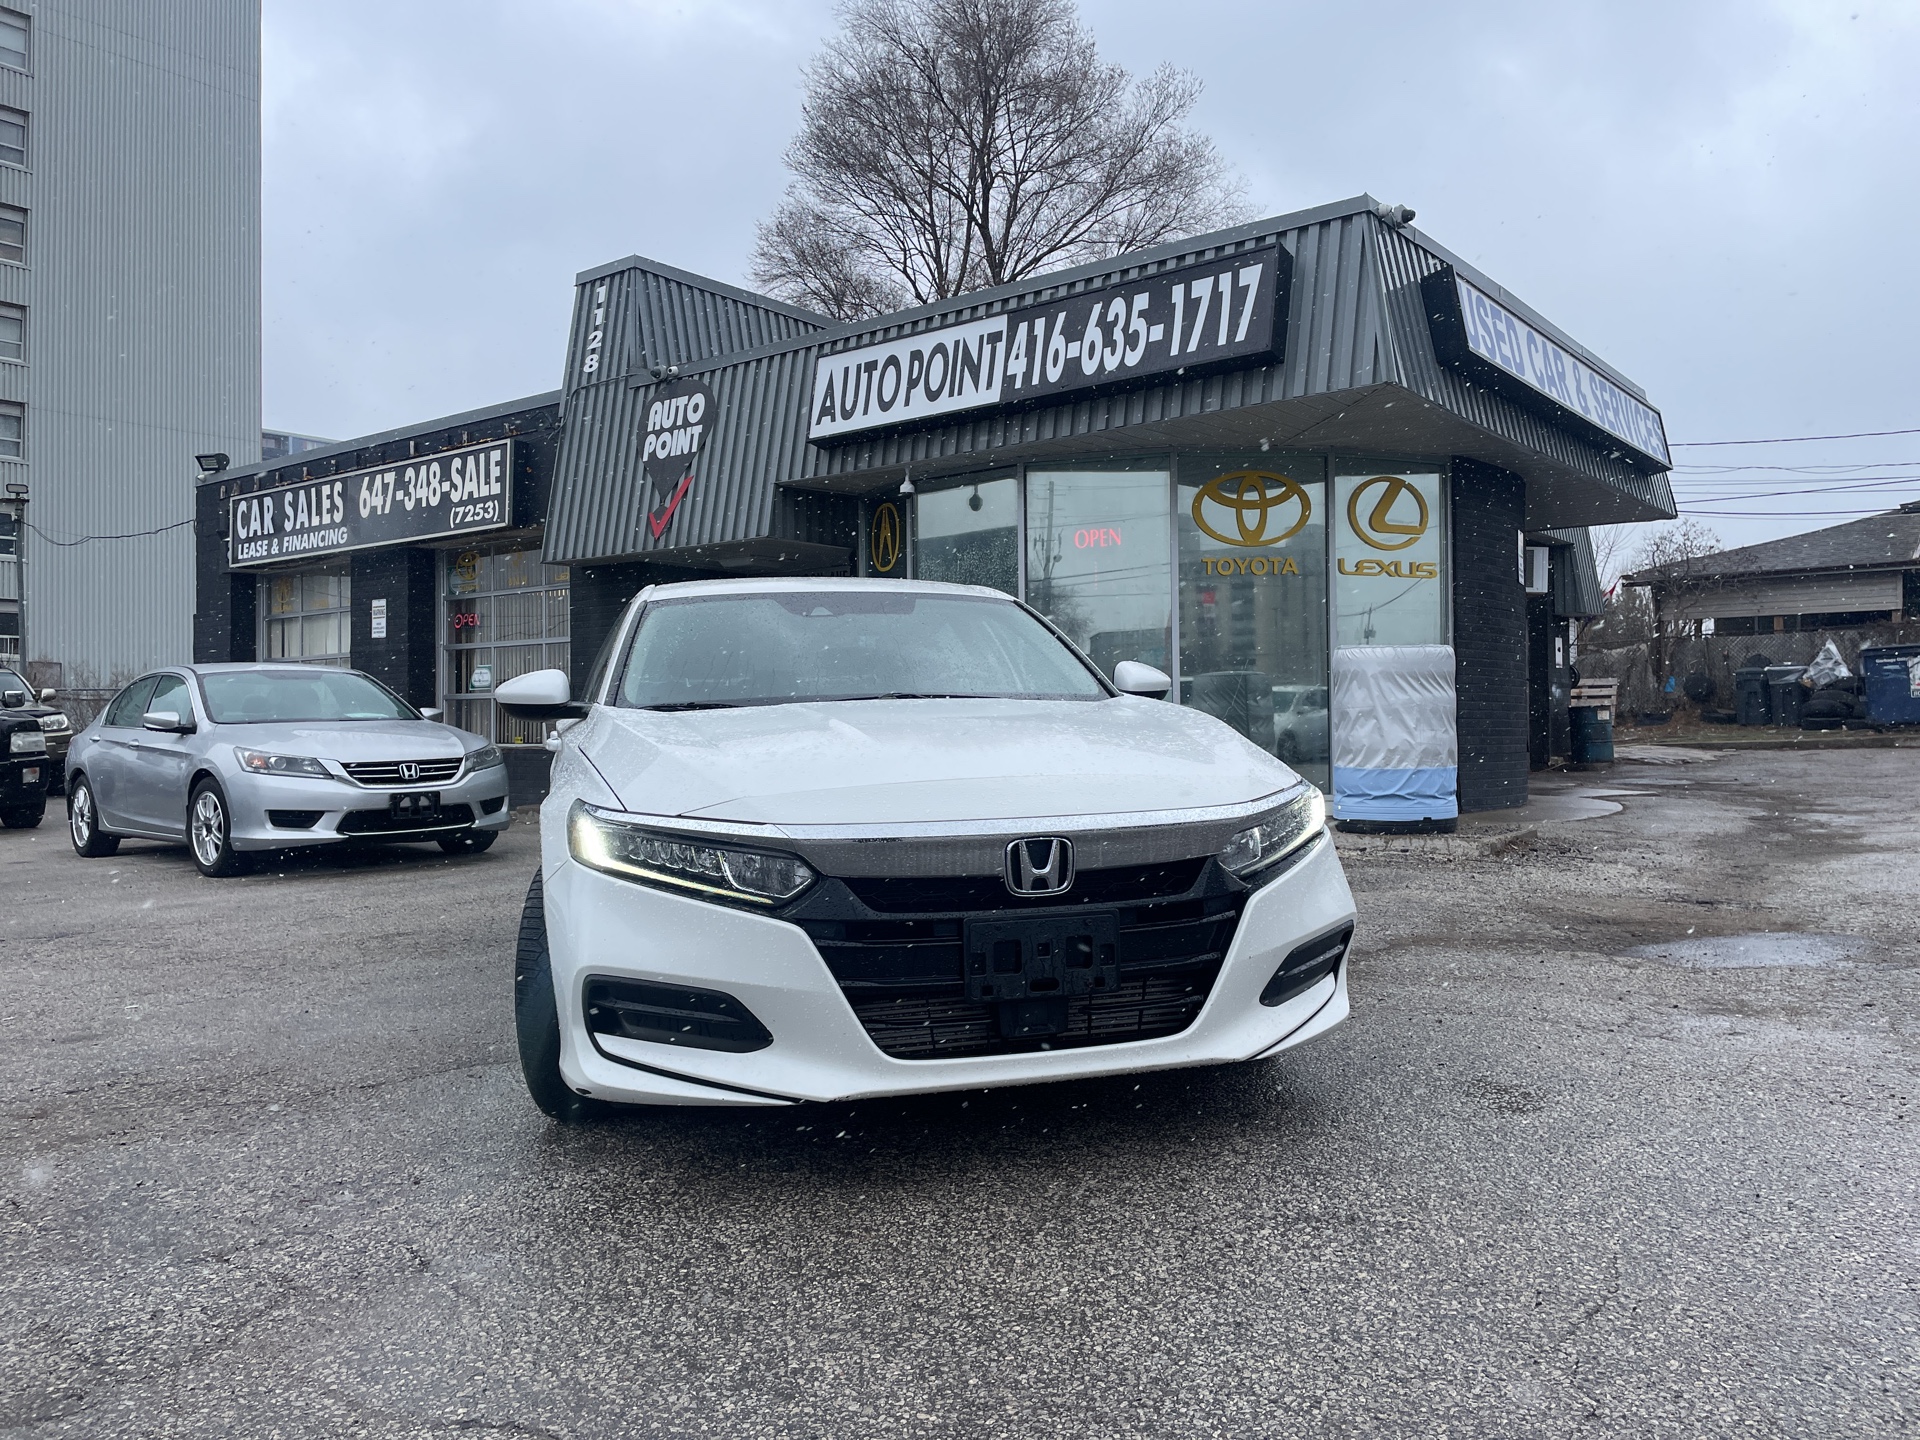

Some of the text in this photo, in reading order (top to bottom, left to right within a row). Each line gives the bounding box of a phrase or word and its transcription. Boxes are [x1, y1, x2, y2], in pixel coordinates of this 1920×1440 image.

[583, 285, 607, 373] 1128
[1007, 263, 1263, 389] 416-635-1717
[815, 329, 1003, 425] AUTO POINT
[1457, 281, 1667, 461] USED CAR & SERVICES
[647, 393, 705, 432] AUTO
[643, 425, 702, 462] POINT
[236, 449, 501, 540] CAR SALES 647-348-SALE
[450, 500, 499, 528] (7253)
[238, 527, 348, 560] LEASE & FINANCING
[1074, 527, 1122, 549] OPEN
[1201, 556, 1299, 576] TOYOTA
[1337, 557, 1438, 579] LEXUS
[454, 613, 480, 628] OPEN
